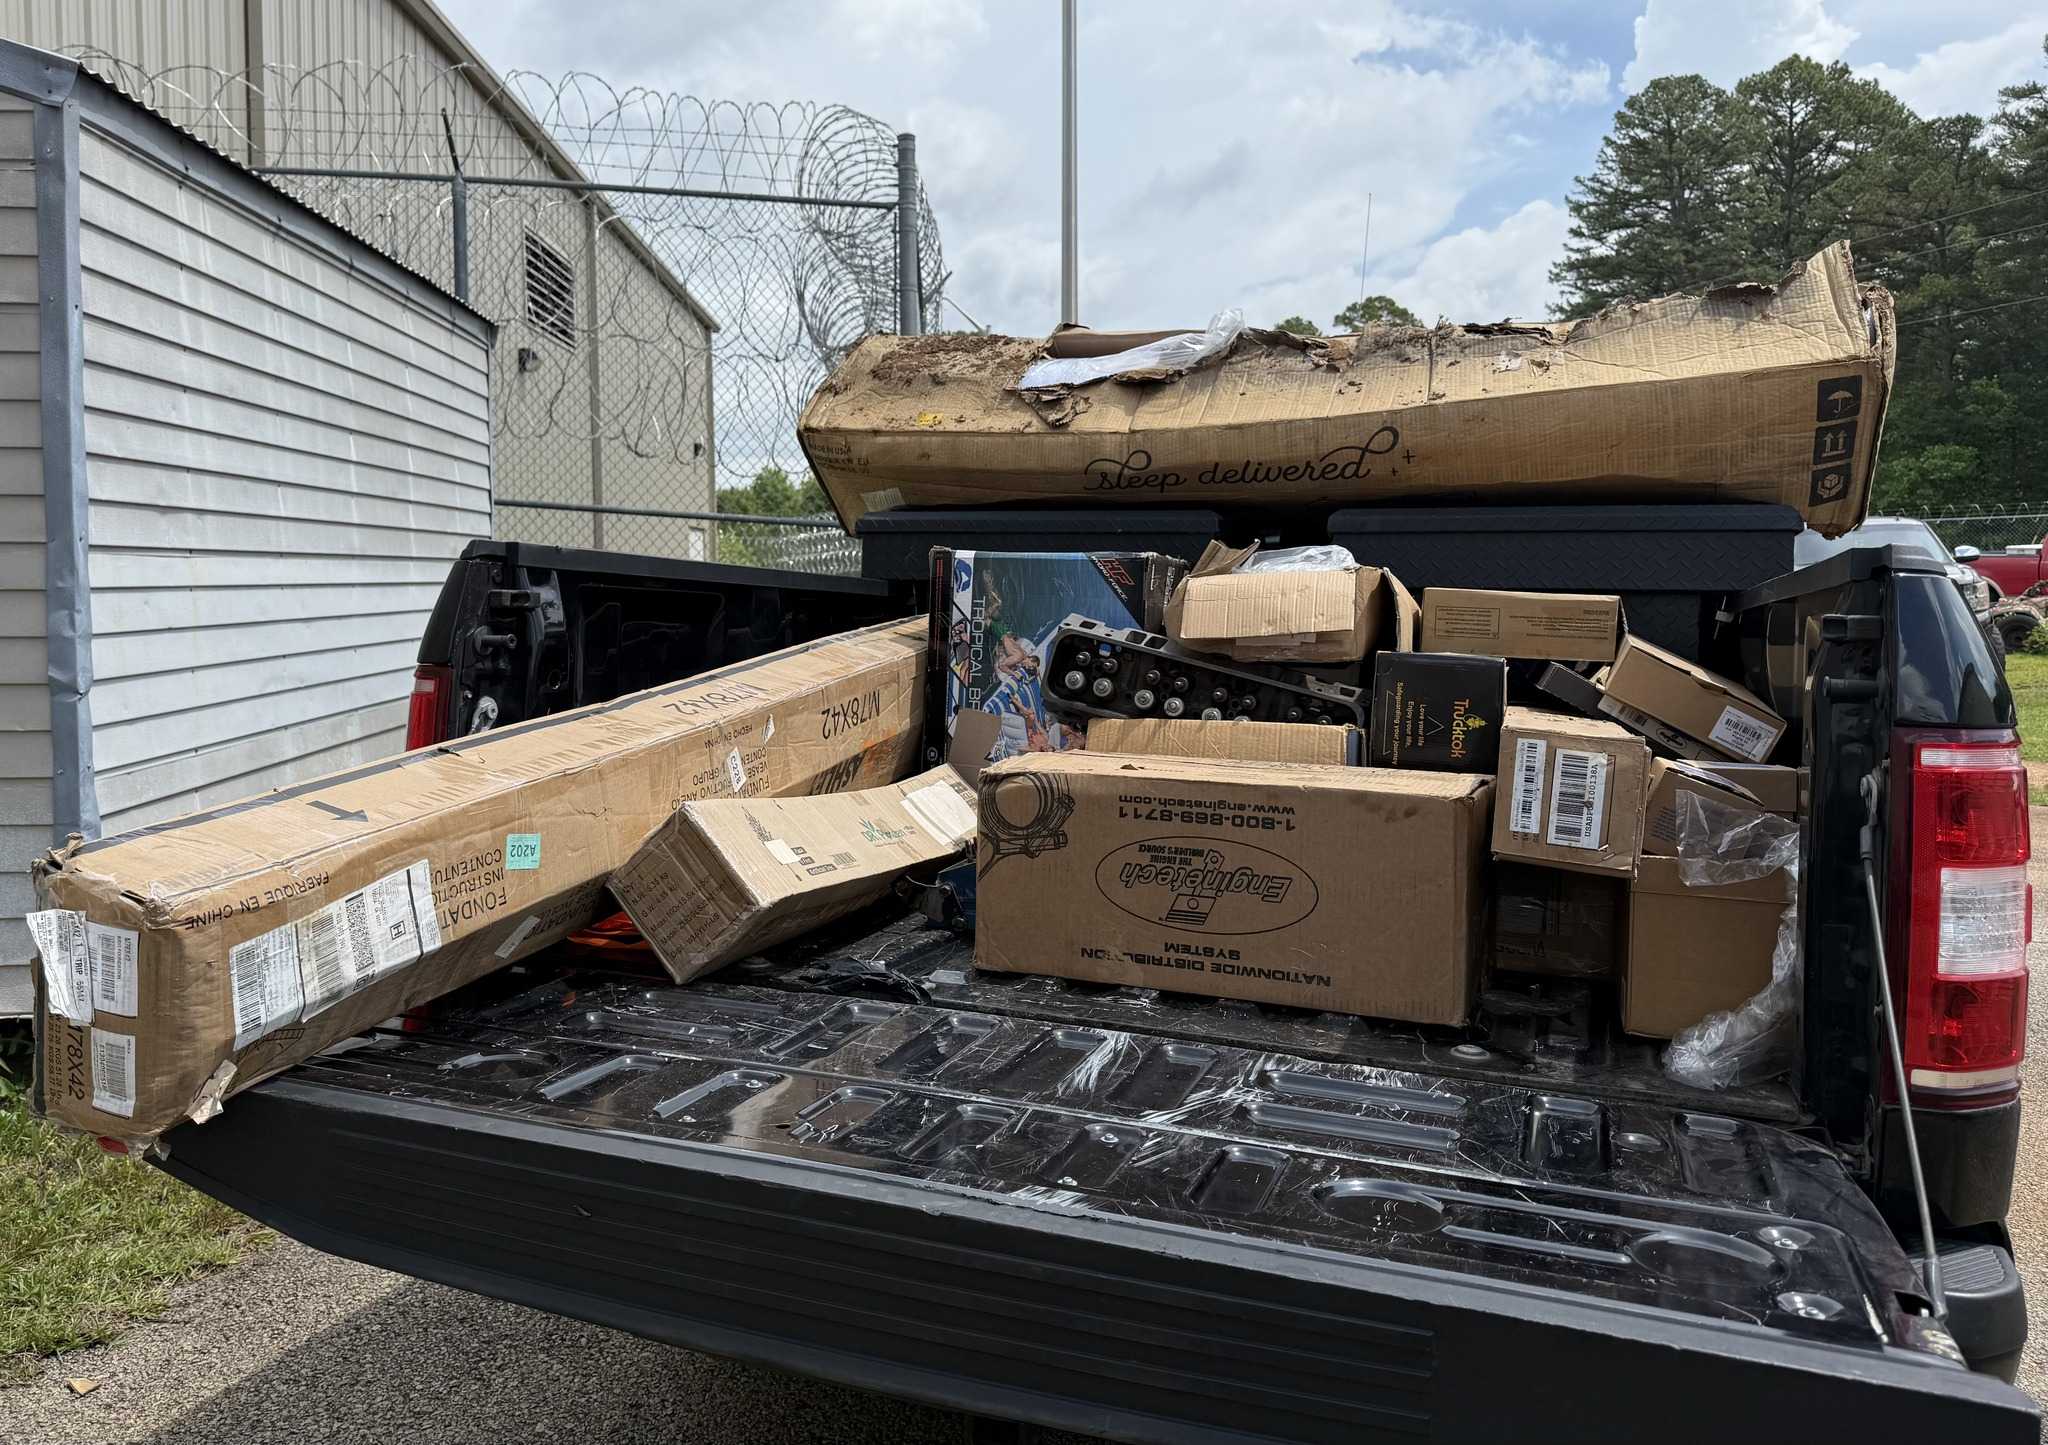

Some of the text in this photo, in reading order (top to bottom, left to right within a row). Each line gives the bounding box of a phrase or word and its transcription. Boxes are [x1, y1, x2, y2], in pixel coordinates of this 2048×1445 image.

[1084, 426, 1399, 493] sleep delivered
[968, 596, 986, 683] TROPICAL
[821, 689, 880, 740] M78X42
[1419, 704, 1427, 718] Love
[1451, 699, 1469, 758] Trucktok
[693, 767, 720, 786] GRUPO
[729, 755, 742, 786] C228
[748, 761, 769, 779] VEASE
[1118, 794, 1296, 816] www.enginetech.com
[1119, 806, 1296, 832] 1-800-869-8711
[510, 844, 537, 858] A202
[1138, 843, 1167, 855] SOURCE
[1149, 854, 1193, 867] THE ENGINE
[432, 848, 503, 886] CONTENTU
[1119, 862, 1293, 904] Enginetech
[184, 871, 330, 931] FABRIQUE EN CHINE
[441, 886, 507, 930] FONDAT
[1164, 941, 1241, 961] SYSTEM
[74, 959, 83, 975] TRIP
[1080, 946, 1332, 988] NATIONWIDE DISTRIBUON
